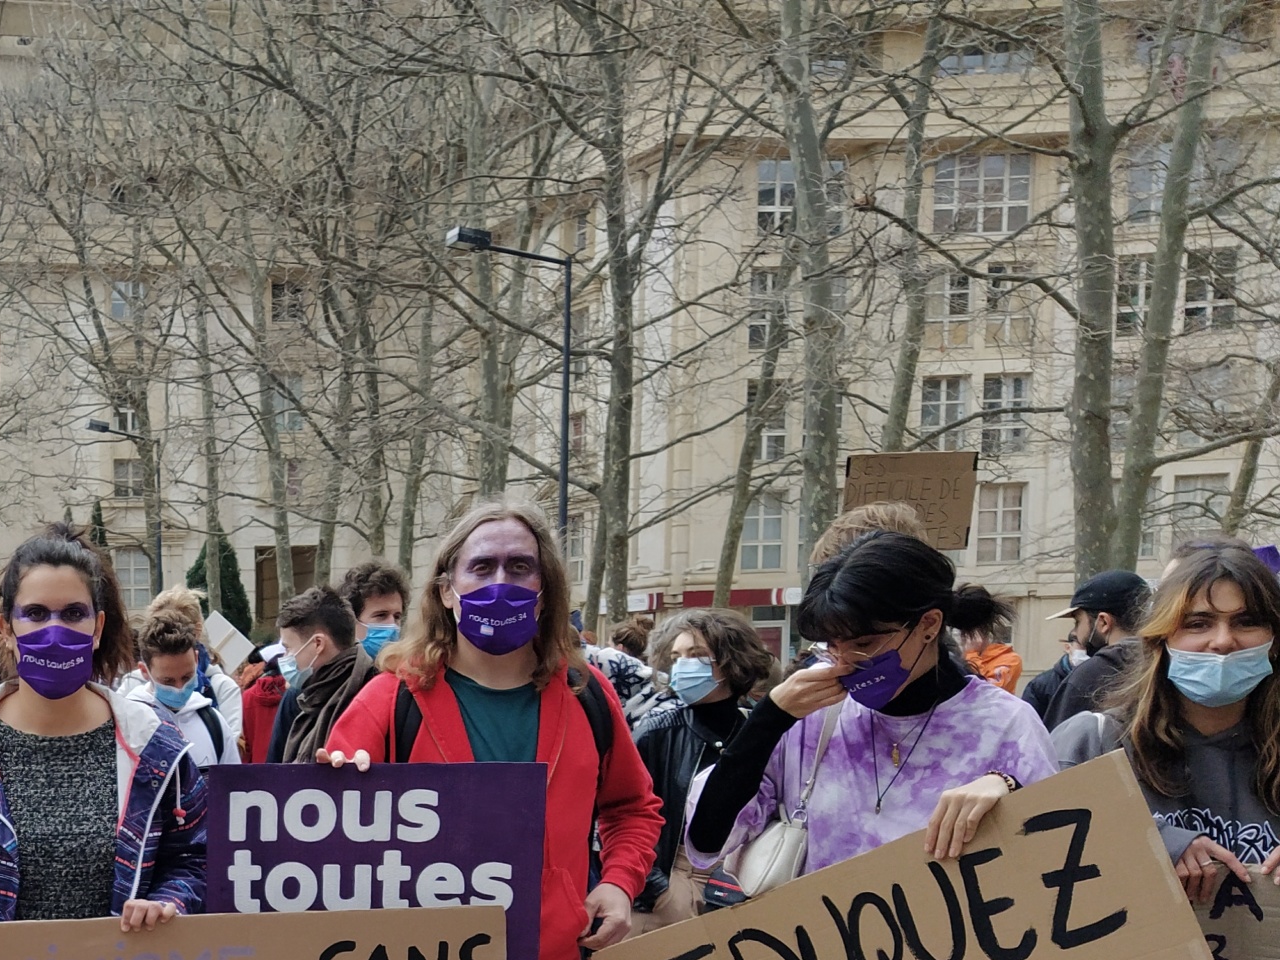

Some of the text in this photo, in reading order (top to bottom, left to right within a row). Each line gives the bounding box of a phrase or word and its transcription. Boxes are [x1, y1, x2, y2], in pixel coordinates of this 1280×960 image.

[845, 477, 961, 505] DIFFICILE DE
[22, 654, 45, 666] nous
[228, 788, 441, 843] nous
[227, 849, 514, 914] toutes
